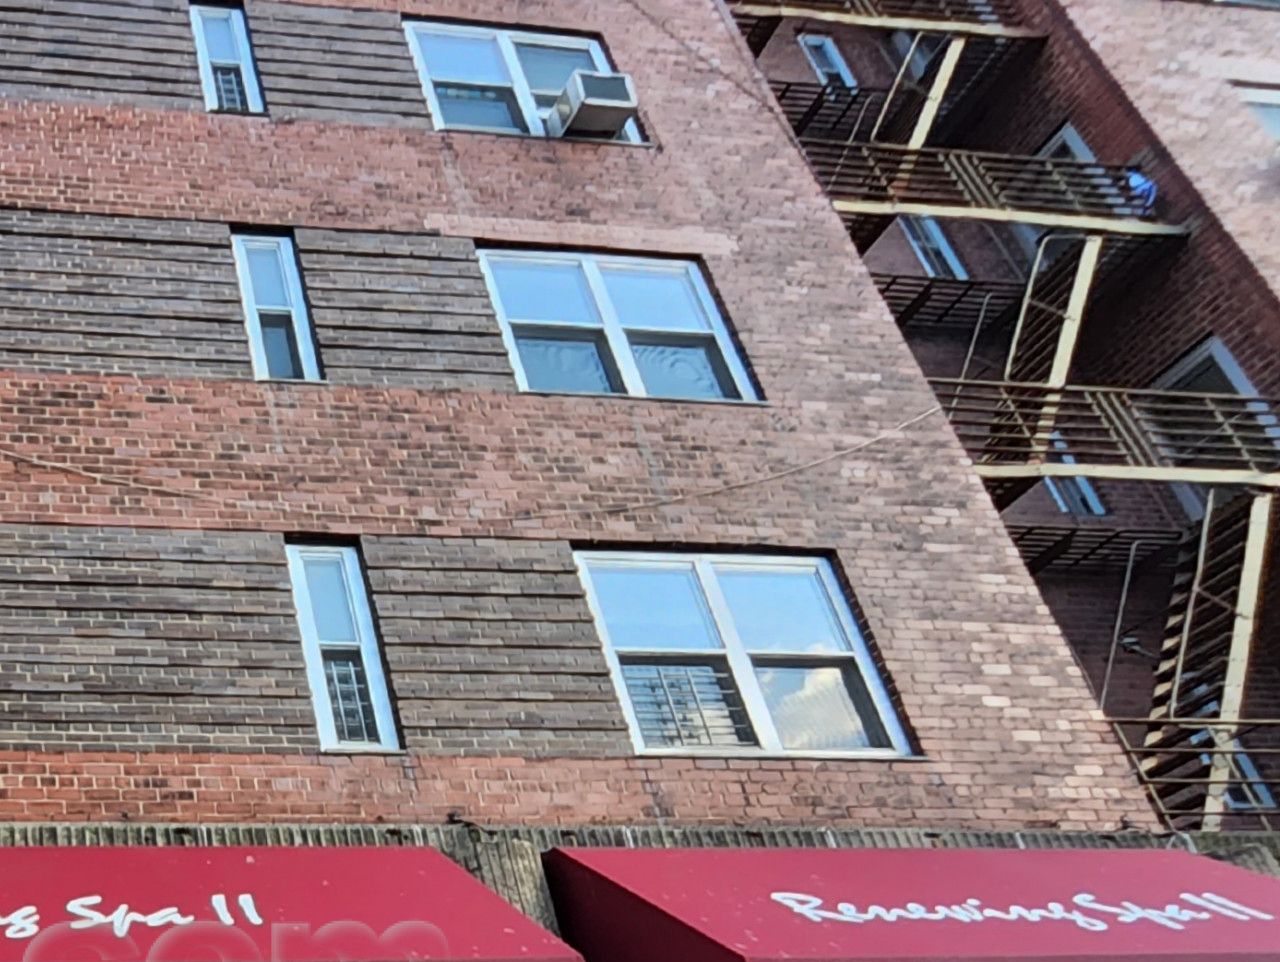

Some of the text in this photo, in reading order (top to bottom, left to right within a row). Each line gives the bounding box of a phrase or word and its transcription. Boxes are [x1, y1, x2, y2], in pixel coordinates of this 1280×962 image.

[66, 895, 195, 938] Spa
[770, 892, 1109, 932] Renewing
[1072, 892, 1211, 931] Spa
